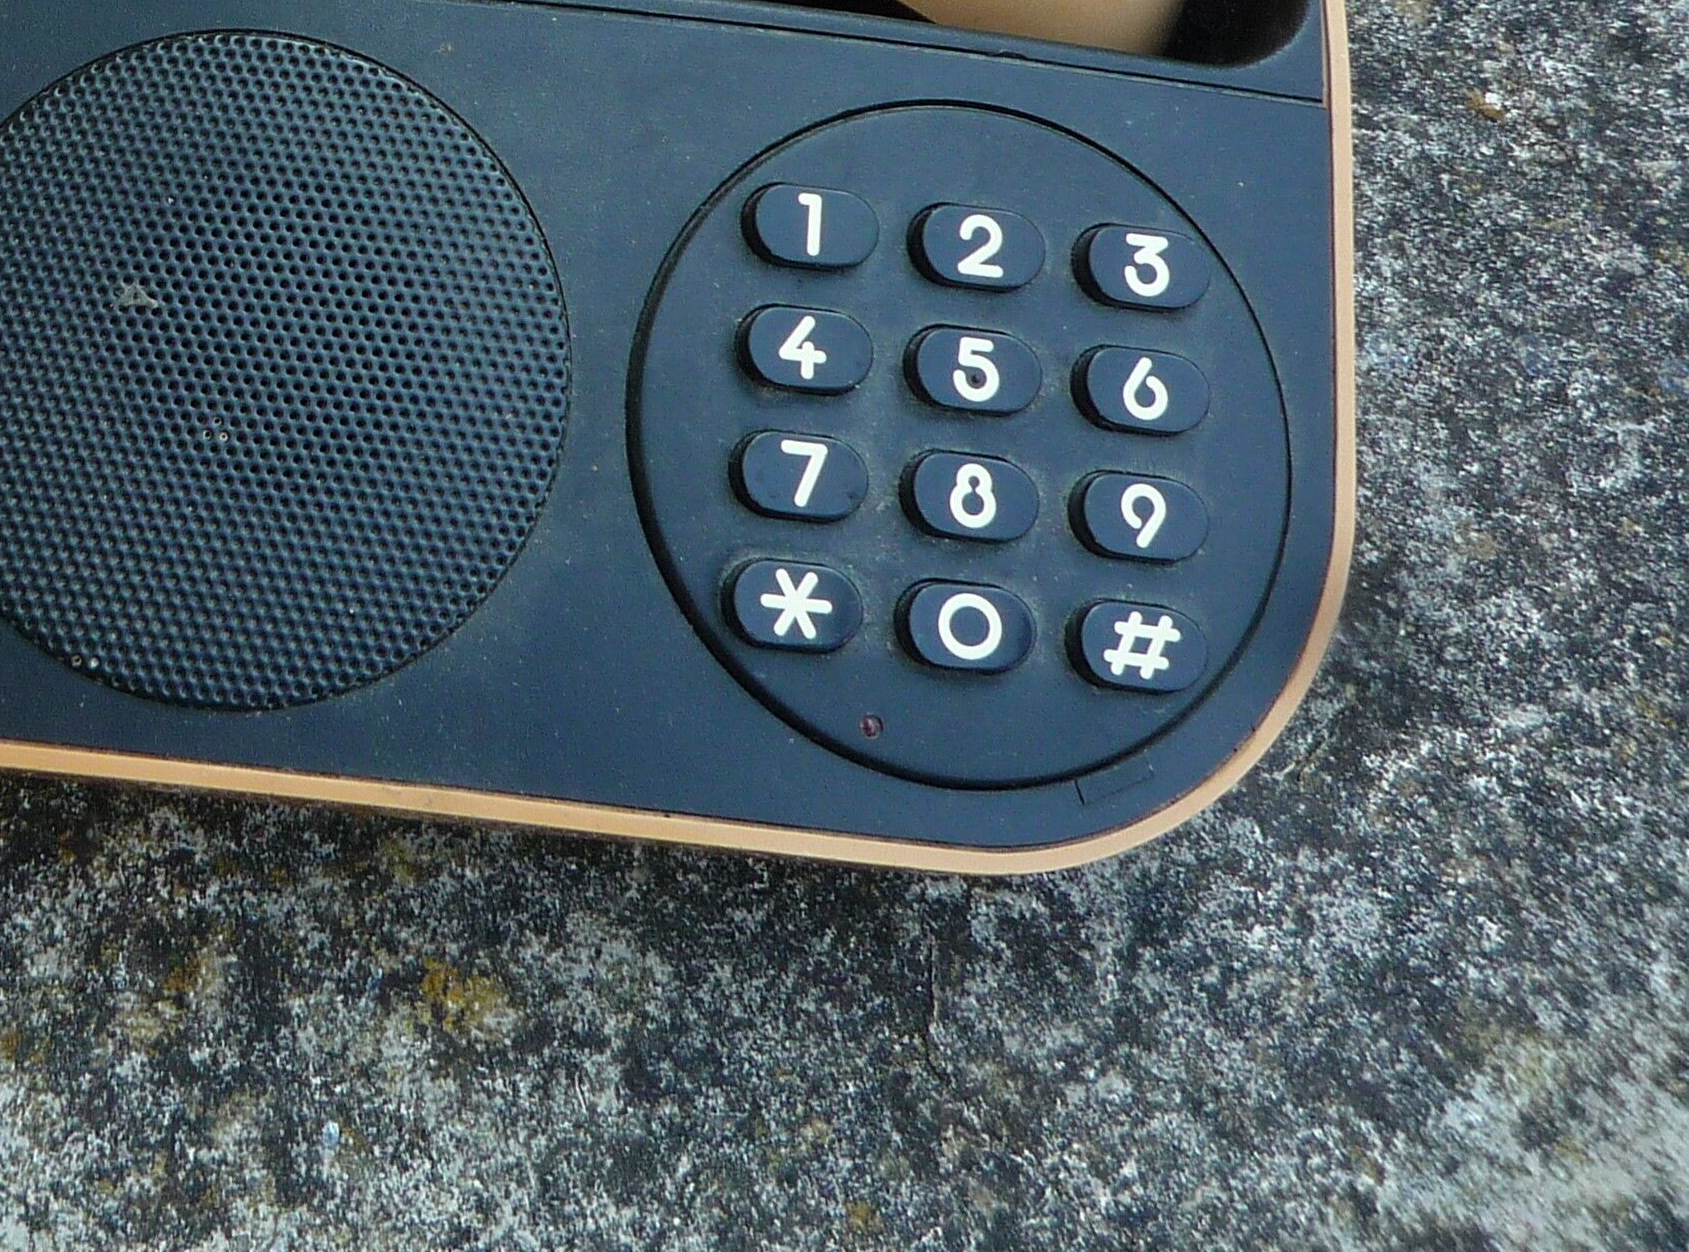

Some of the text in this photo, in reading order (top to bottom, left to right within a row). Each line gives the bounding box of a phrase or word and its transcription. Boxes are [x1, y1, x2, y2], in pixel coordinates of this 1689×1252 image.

[797, 192, 1170, 297] 1 2 3
[778, 315, 1169, 421] 4 5 6
[780, 439, 1167, 549] 7 8 9
[1103, 611, 1181, 680] #
